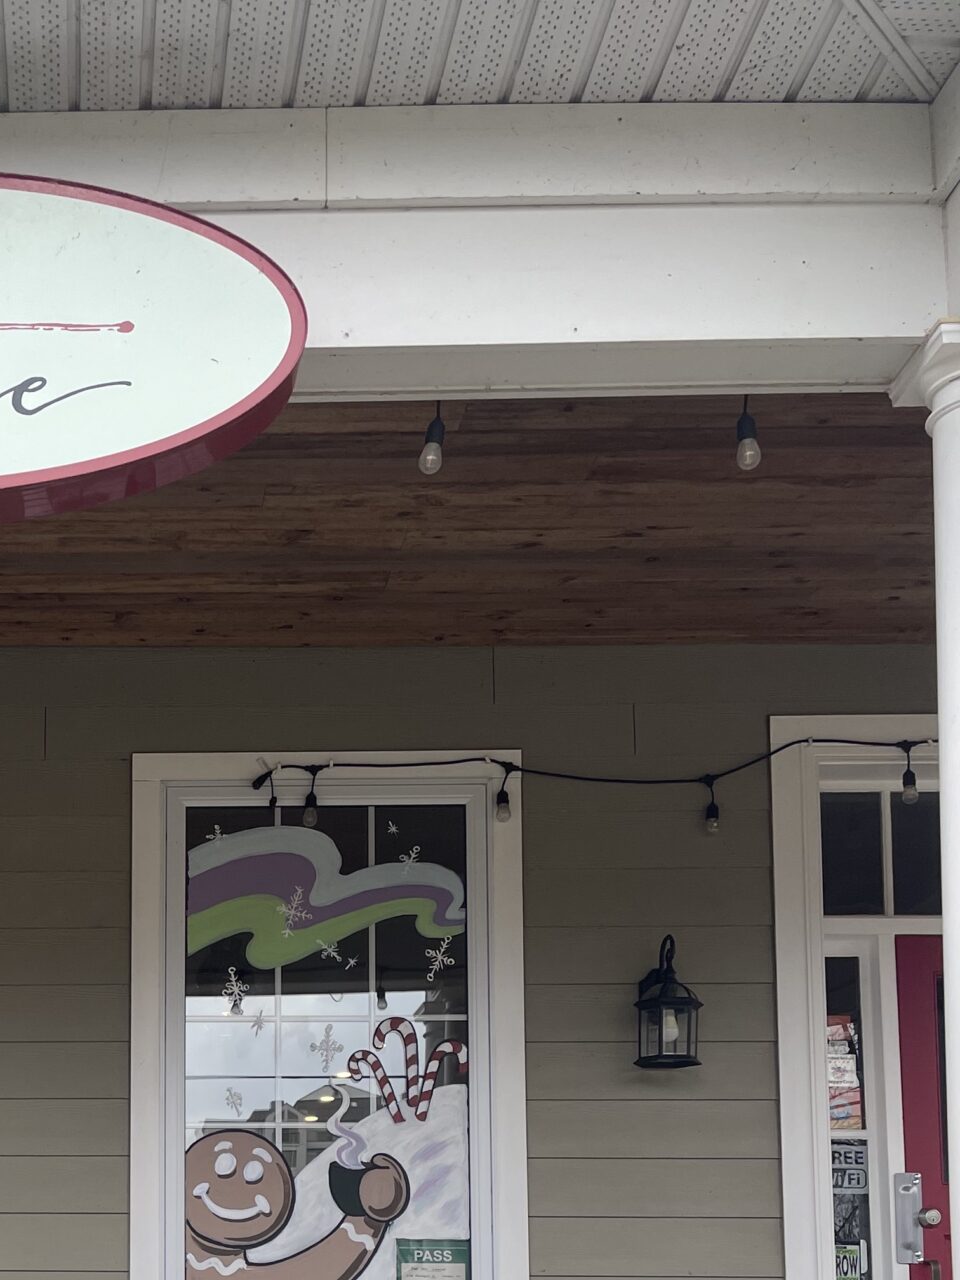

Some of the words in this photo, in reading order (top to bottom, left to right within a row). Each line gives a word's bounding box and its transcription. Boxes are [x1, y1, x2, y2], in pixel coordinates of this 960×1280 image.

[831, 1150, 865, 1165] REE
[414, 1250, 453, 1262] PASS
[835, 1254, 858, 1277] ROW
